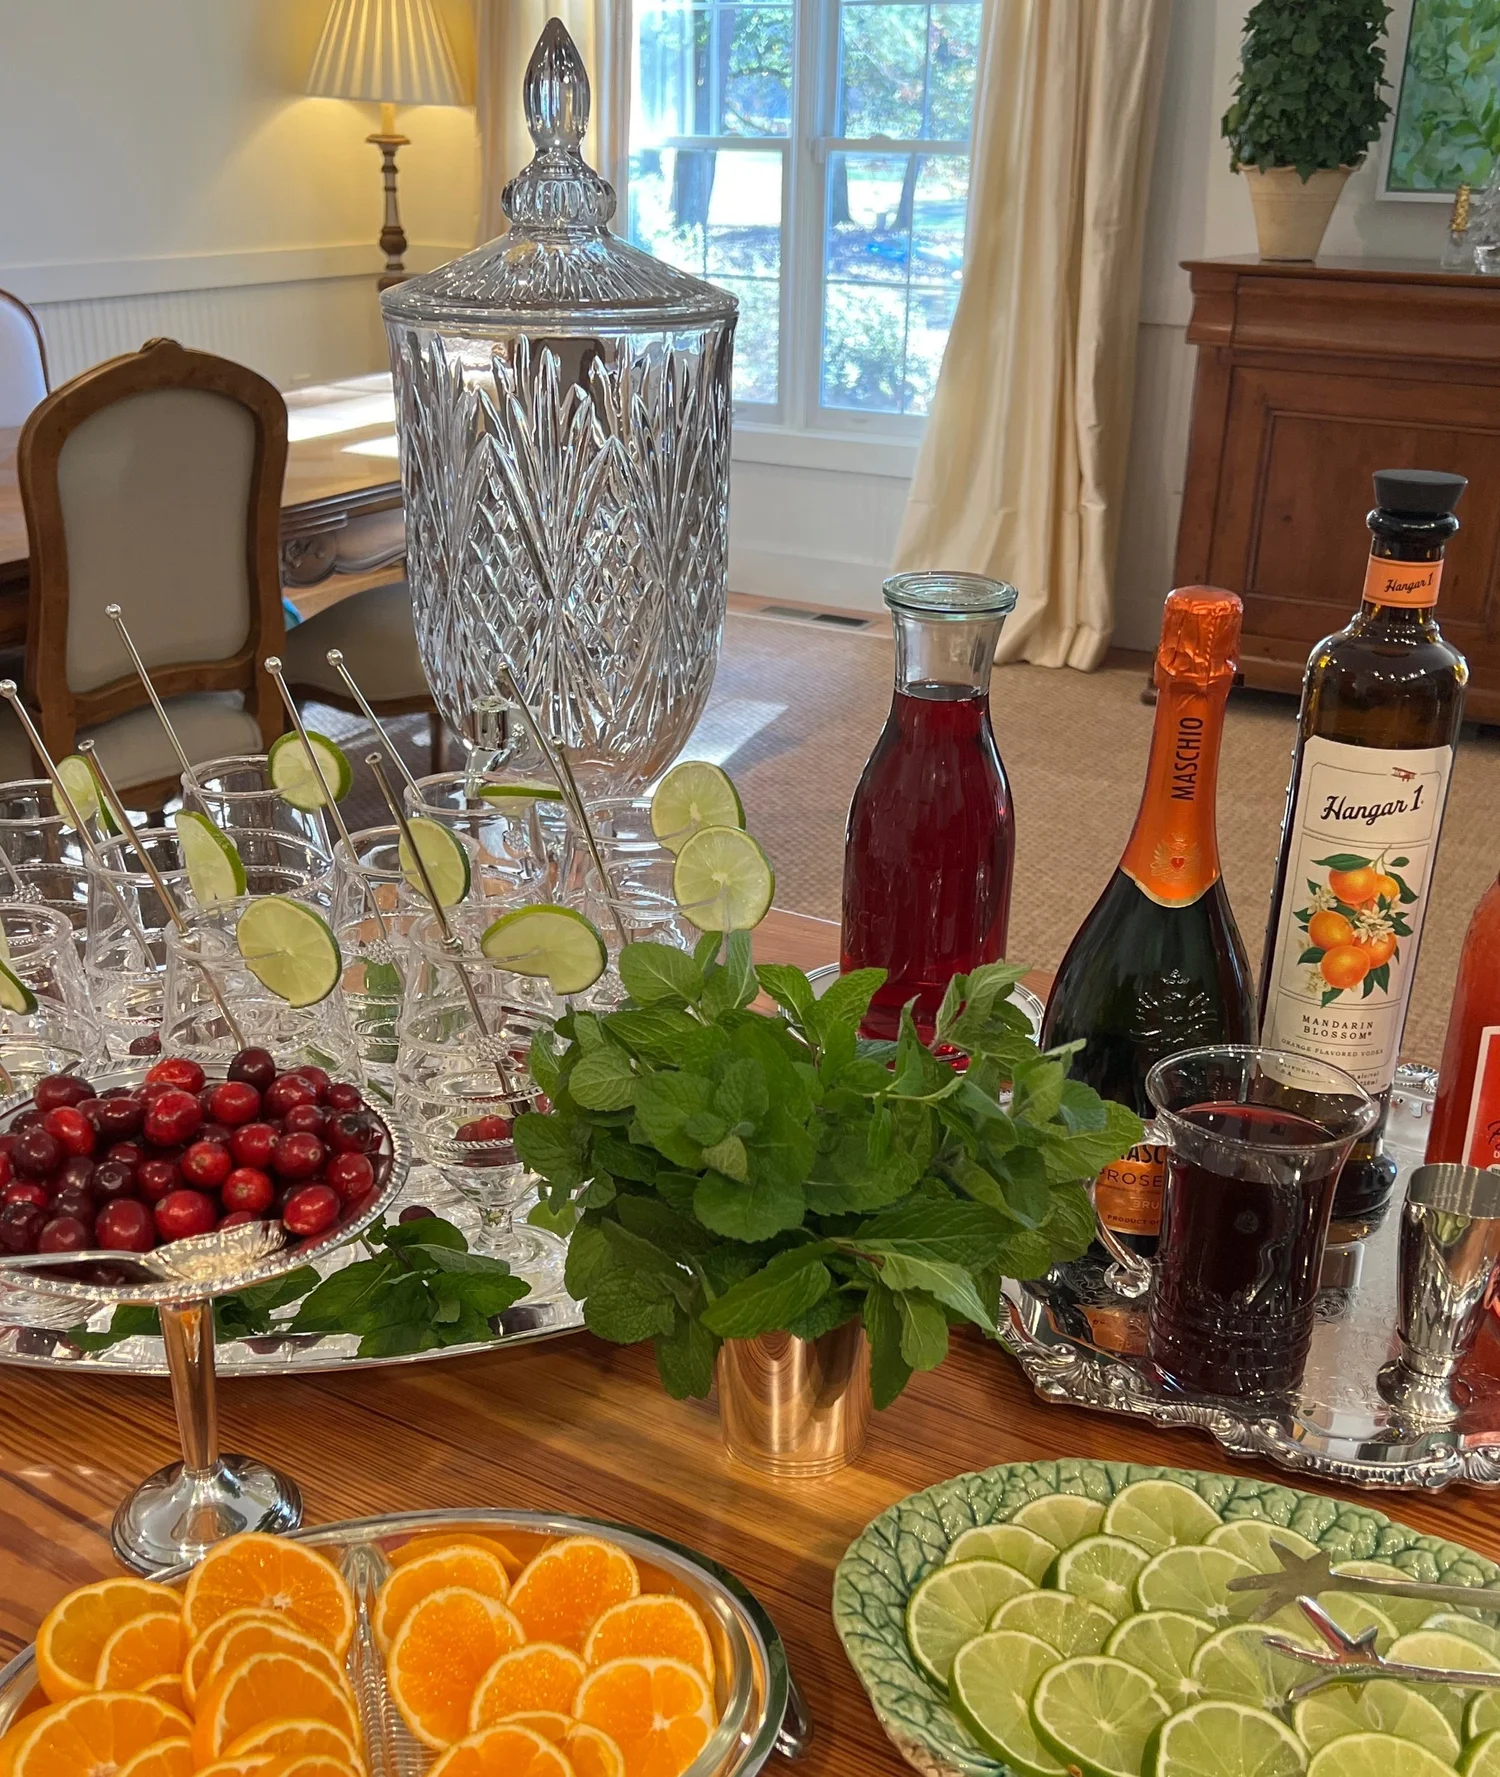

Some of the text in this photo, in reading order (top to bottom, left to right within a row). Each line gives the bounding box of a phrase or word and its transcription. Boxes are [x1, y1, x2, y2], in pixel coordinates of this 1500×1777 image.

[1384, 571, 1434, 594] Hangar 1
[1170, 717, 1204, 801] MASCHIO
[1320, 784, 1424, 826] Hangar 1
[1302, 1014, 1374, 1030] MANDARIN
[1281, 1038, 1384, 1057] ORANGE FLAVORED VODKA
[1120, 1144, 1164, 1165] ASC
[1107, 1214, 1147, 1225] PRODUCT
